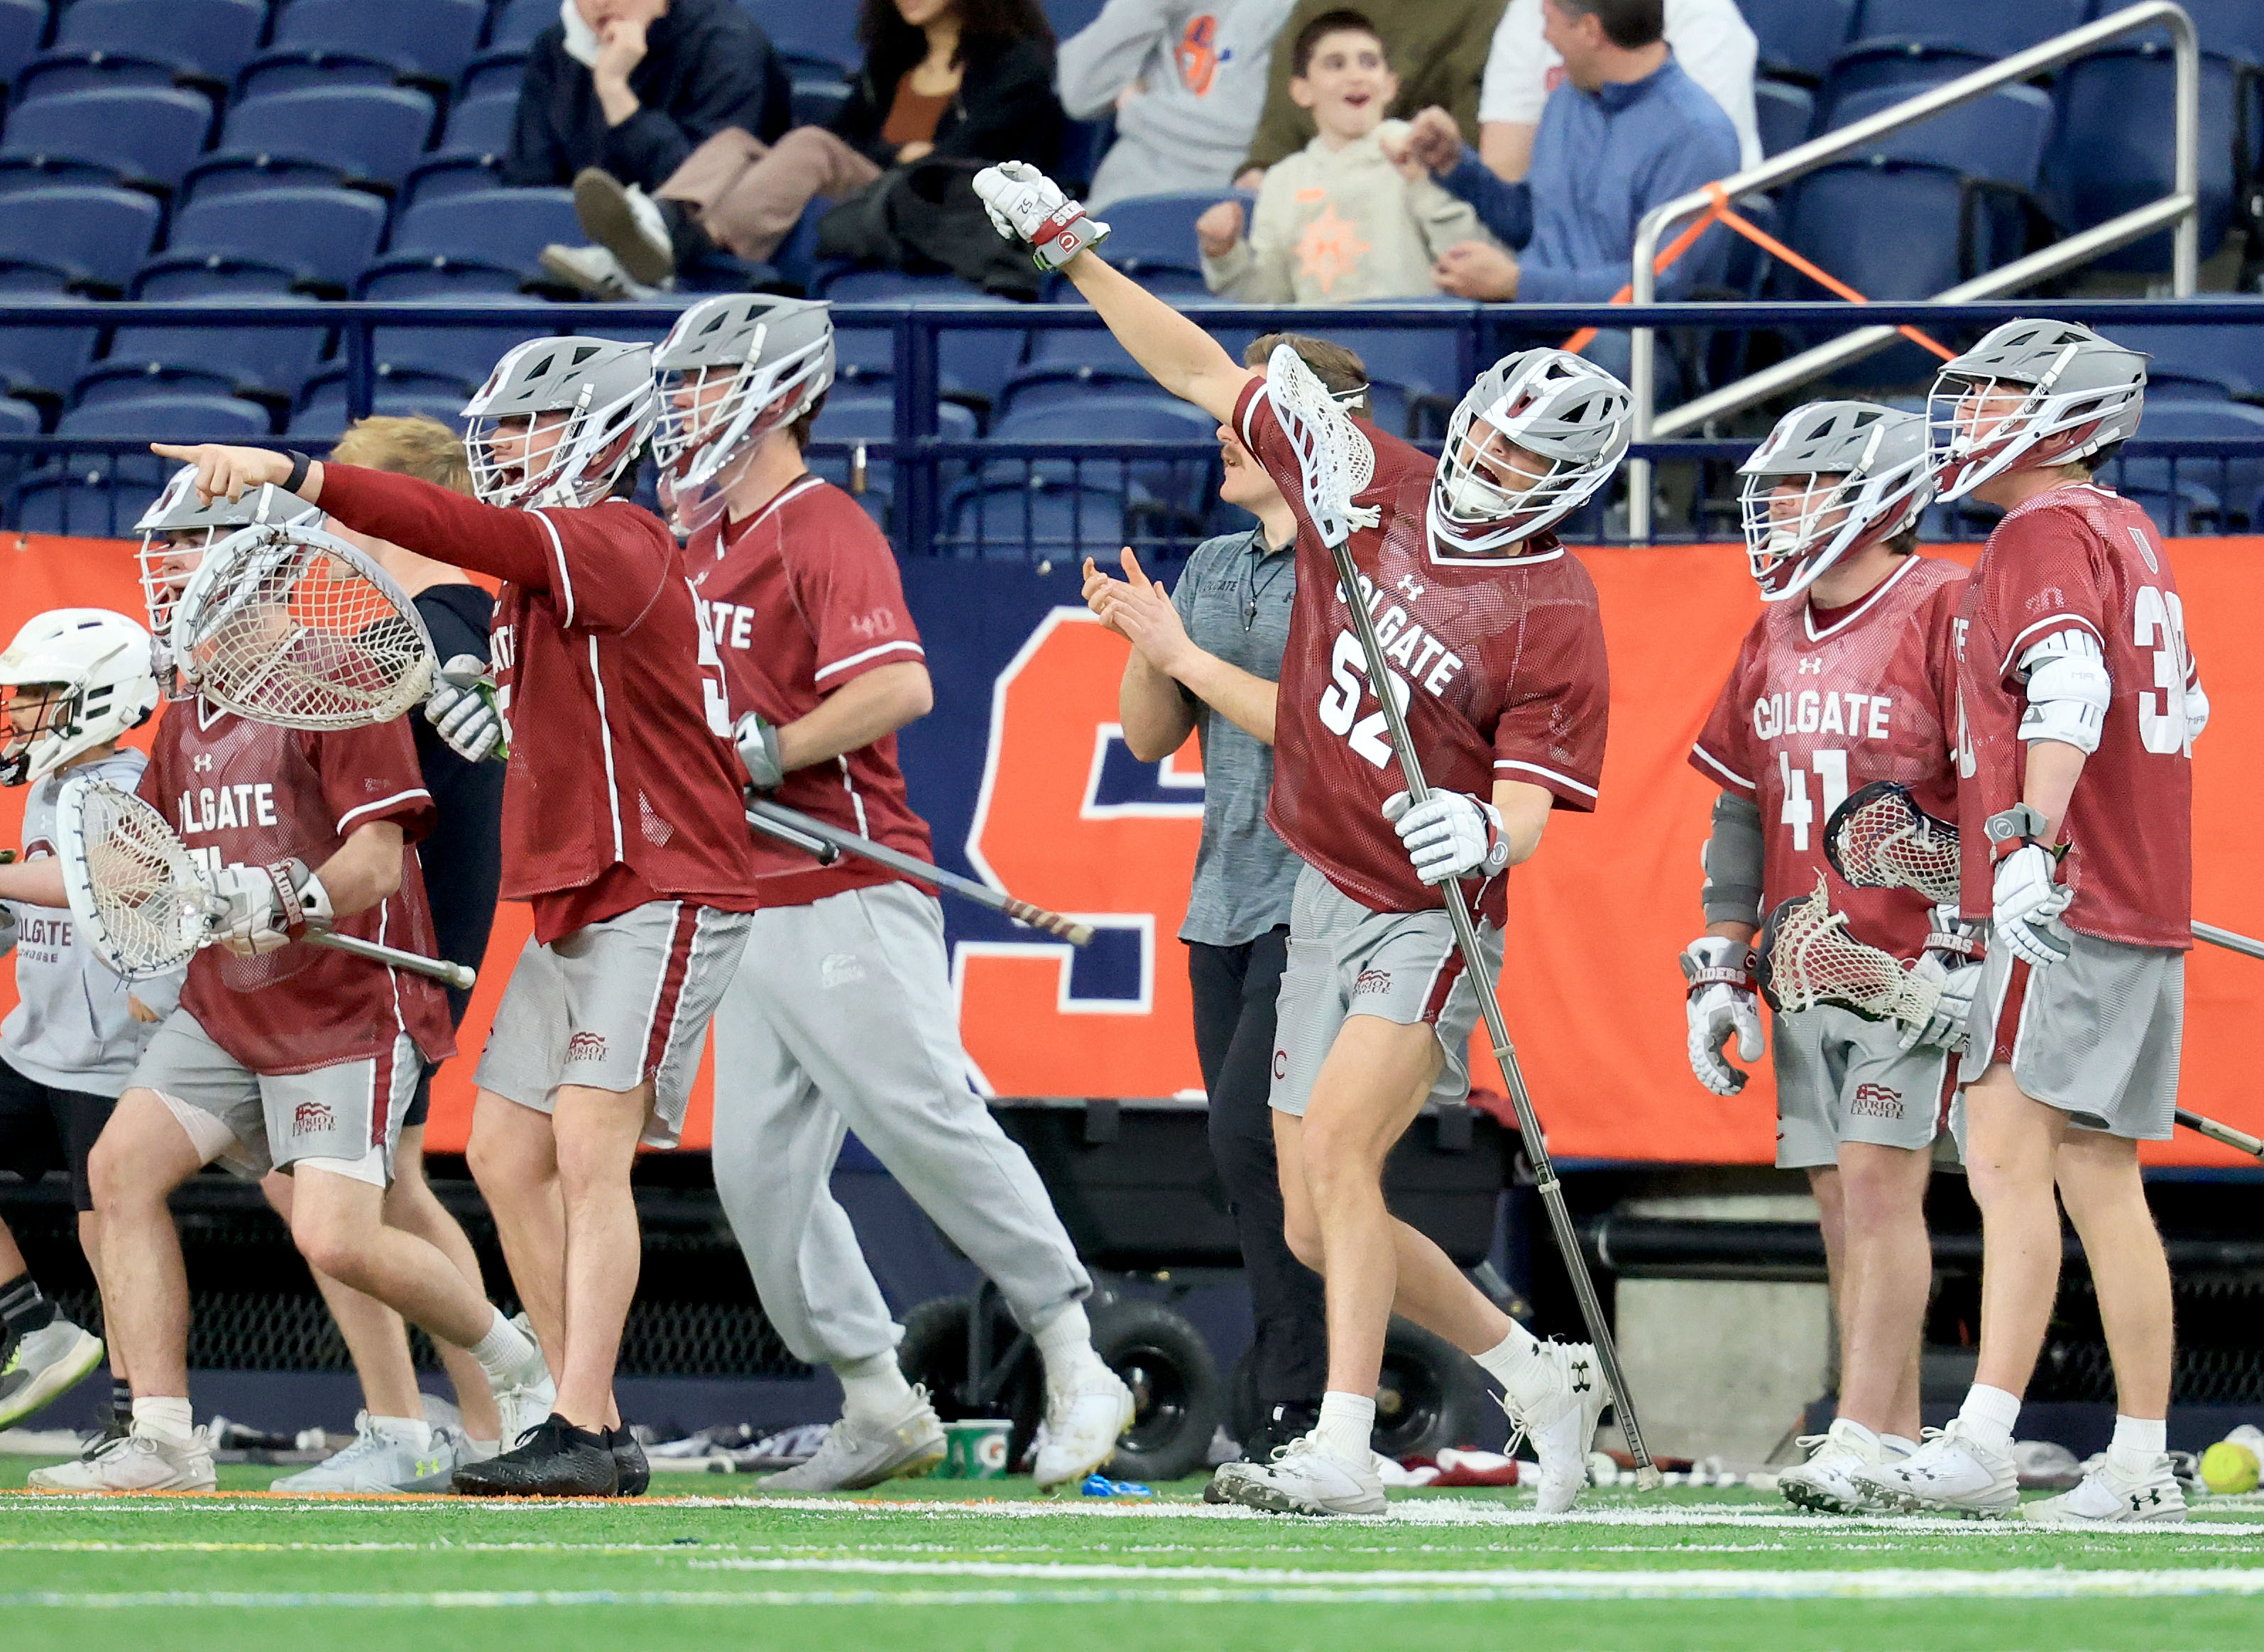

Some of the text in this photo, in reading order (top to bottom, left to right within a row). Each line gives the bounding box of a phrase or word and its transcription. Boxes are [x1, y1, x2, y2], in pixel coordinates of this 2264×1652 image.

[850, 607, 897, 639] 40
[1319, 629, 1411, 770] 52
[1754, 690, 1892, 741] COLGATE
[178, 783, 278, 835] LGATE
[1779, 749, 1849, 851] 41
[1922, 932, 1974, 954] AIDERS
[1850, 1107, 1905, 1120] LEAGUE
[1852, 1099, 1907, 1112] PATRIOT
